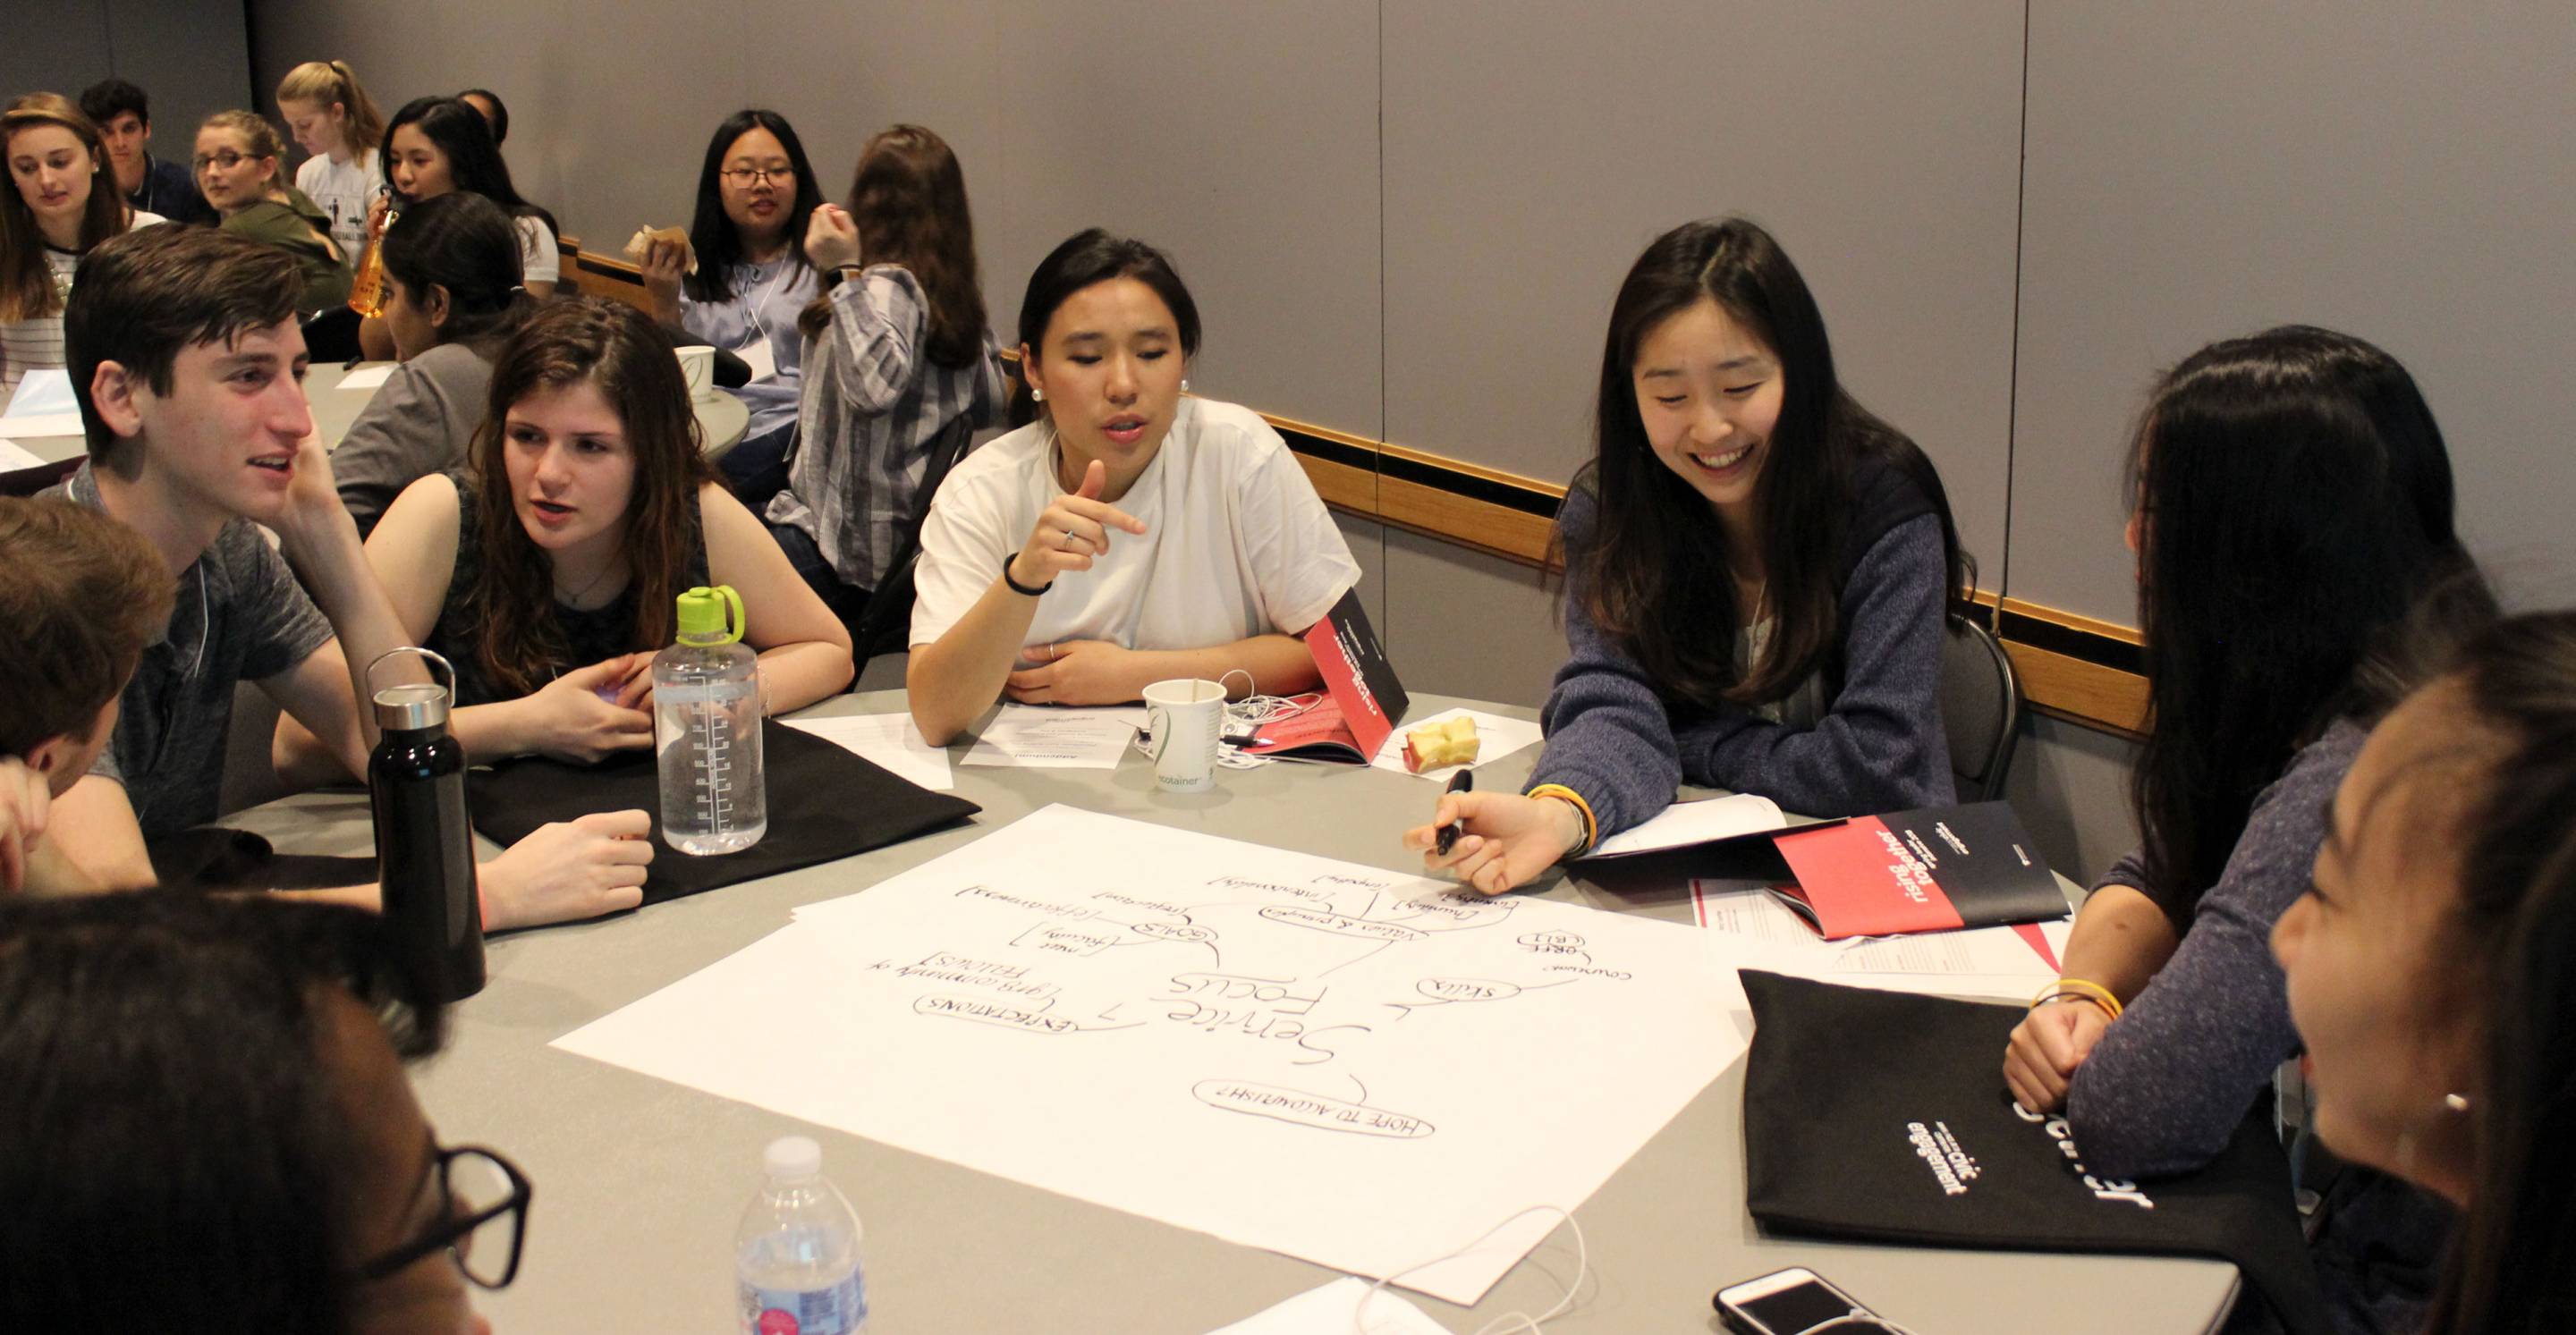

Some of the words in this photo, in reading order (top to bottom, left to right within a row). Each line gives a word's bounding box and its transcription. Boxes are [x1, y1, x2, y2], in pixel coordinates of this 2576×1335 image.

[1333, 634, 1370, 697] together
[1352, 676, 1377, 716] rising
[1876, 830, 1934, 884] together
[1888, 863, 1928, 902] rising
[1142, 924, 1208, 941] GOALS
[928, 999, 1072, 1032] EXPECTATIONS
[1148, 998, 1371, 1065] Service
[1336, 1110, 1360, 1123] TO
[1365, 1114, 1420, 1135] HOPE
[1907, 1122, 1967, 1196] engagement
[1948, 1153, 1981, 1180] civic
